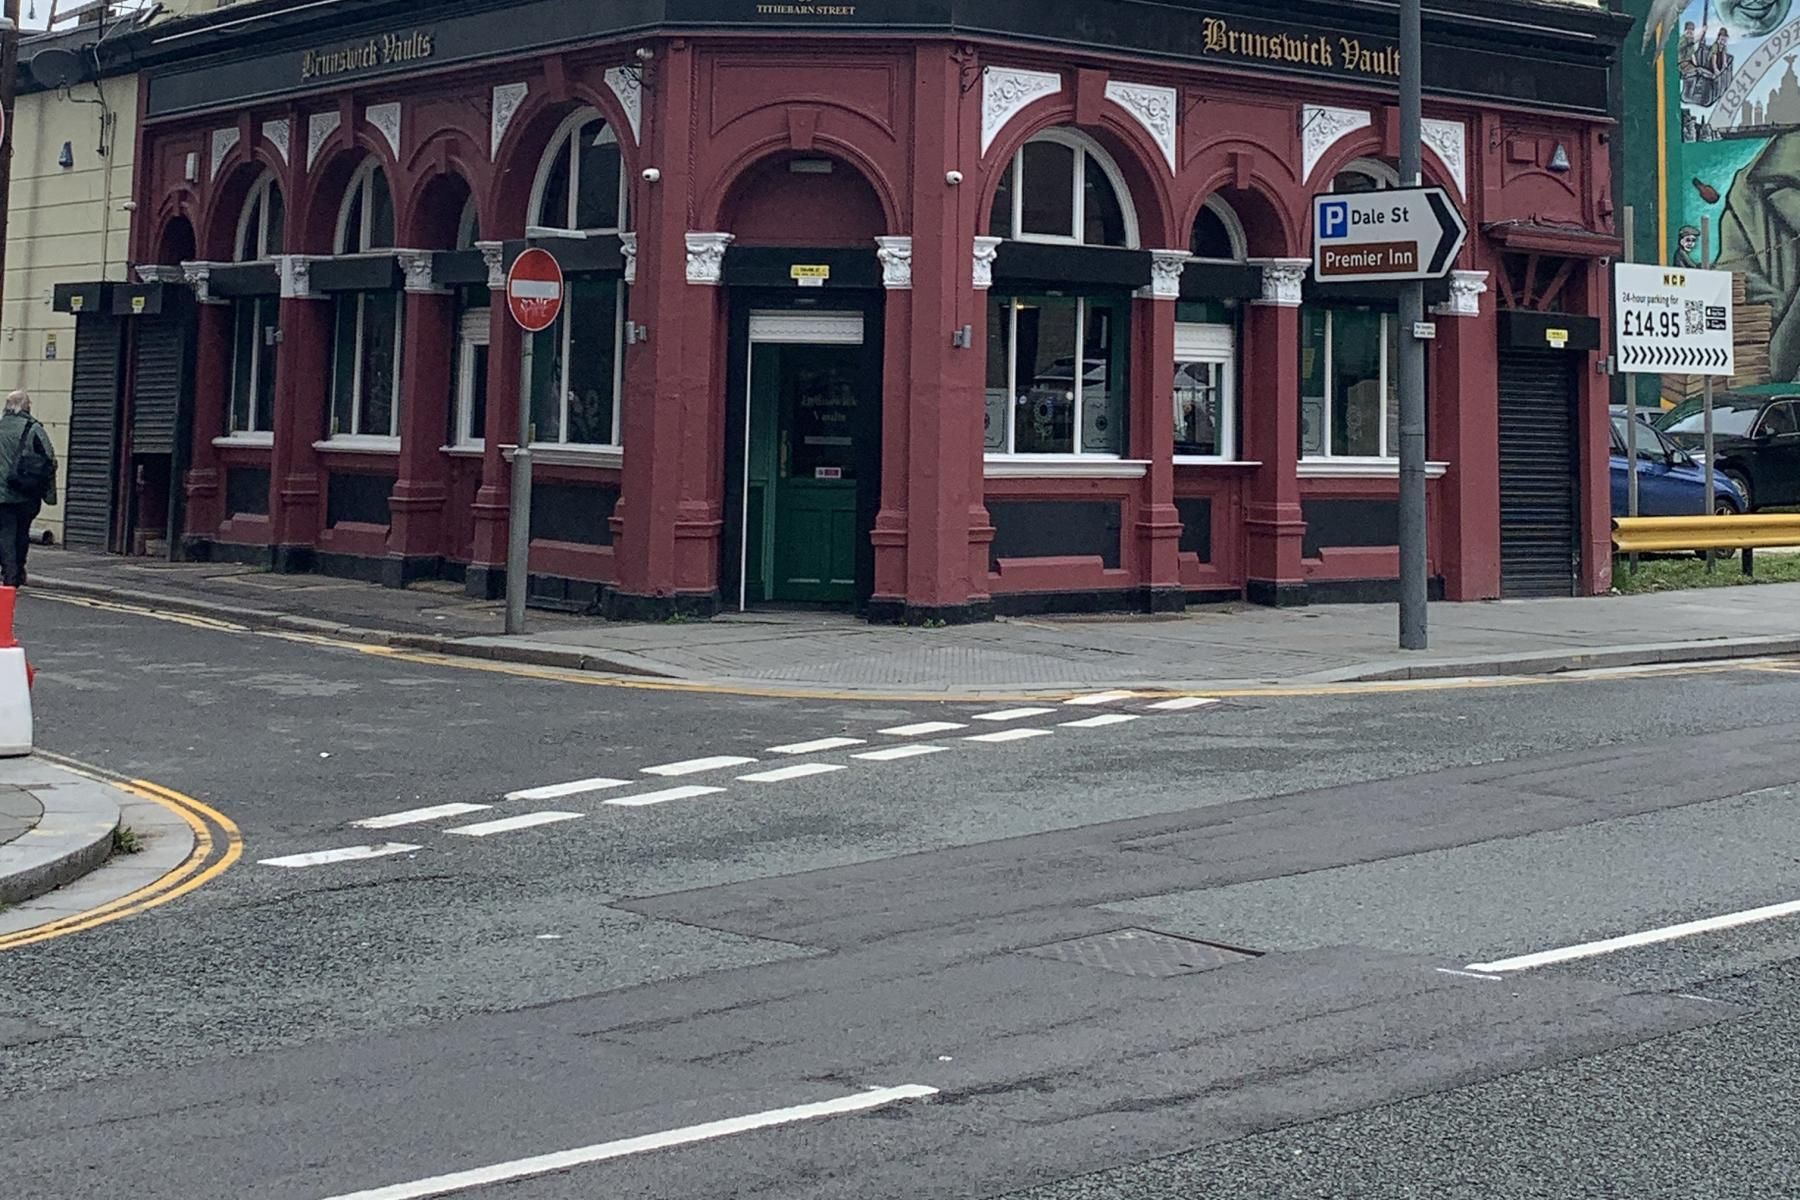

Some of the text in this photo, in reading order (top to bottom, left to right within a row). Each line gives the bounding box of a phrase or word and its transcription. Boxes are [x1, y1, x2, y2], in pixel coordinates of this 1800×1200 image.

[756, 4, 856, 15] TITHEBARN STREET
[301, 31, 432, 80] Brunswick Vaults
[1202, 17, 1401, 77] Brunswick Vault
[1720, 69, 1757, 118] 1841
[1326, 206, 1409, 235] P Dale St
[1325, 249, 1413, 268] Premier Inn
[1622, 309, 1680, 338] £14.95
